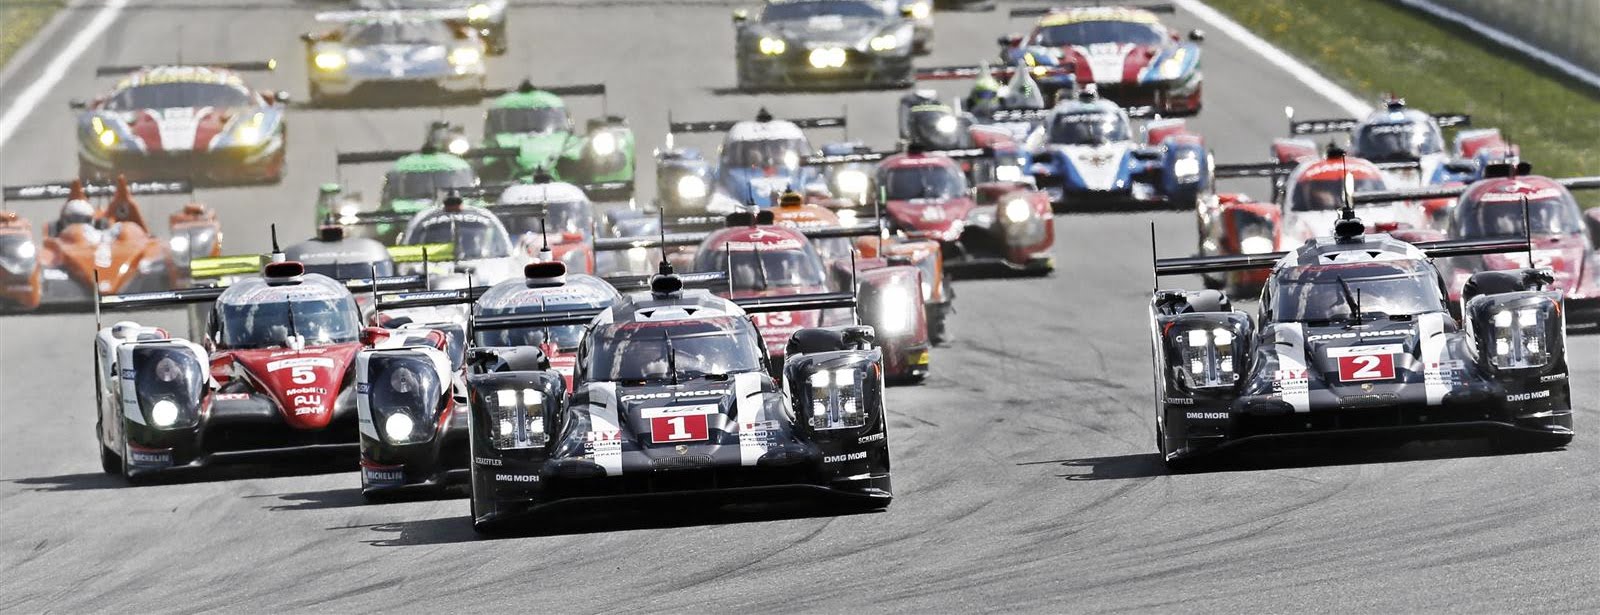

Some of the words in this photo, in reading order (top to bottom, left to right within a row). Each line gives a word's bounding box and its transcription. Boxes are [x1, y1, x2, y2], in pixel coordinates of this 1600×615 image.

[1307, 332, 1357, 342] DMG
[1359, 329, 1416, 338] MORI
[1352, 355, 1382, 379] 2
[291, 366, 317, 385] 5
[286, 388, 315, 396] Mobil
[621, 392, 671, 402] DMG
[674, 389, 731, 398] MORI
[1506, 392, 1531, 401] DMG
[1531, 390, 1550, 399] MORI
[667, 416, 692, 440] 1
[132, 452, 171, 462] MICHELIN
[824, 454, 847, 463] DMG
[847, 451, 867, 460] MORI
[366, 469, 402, 480] MICHELIN
